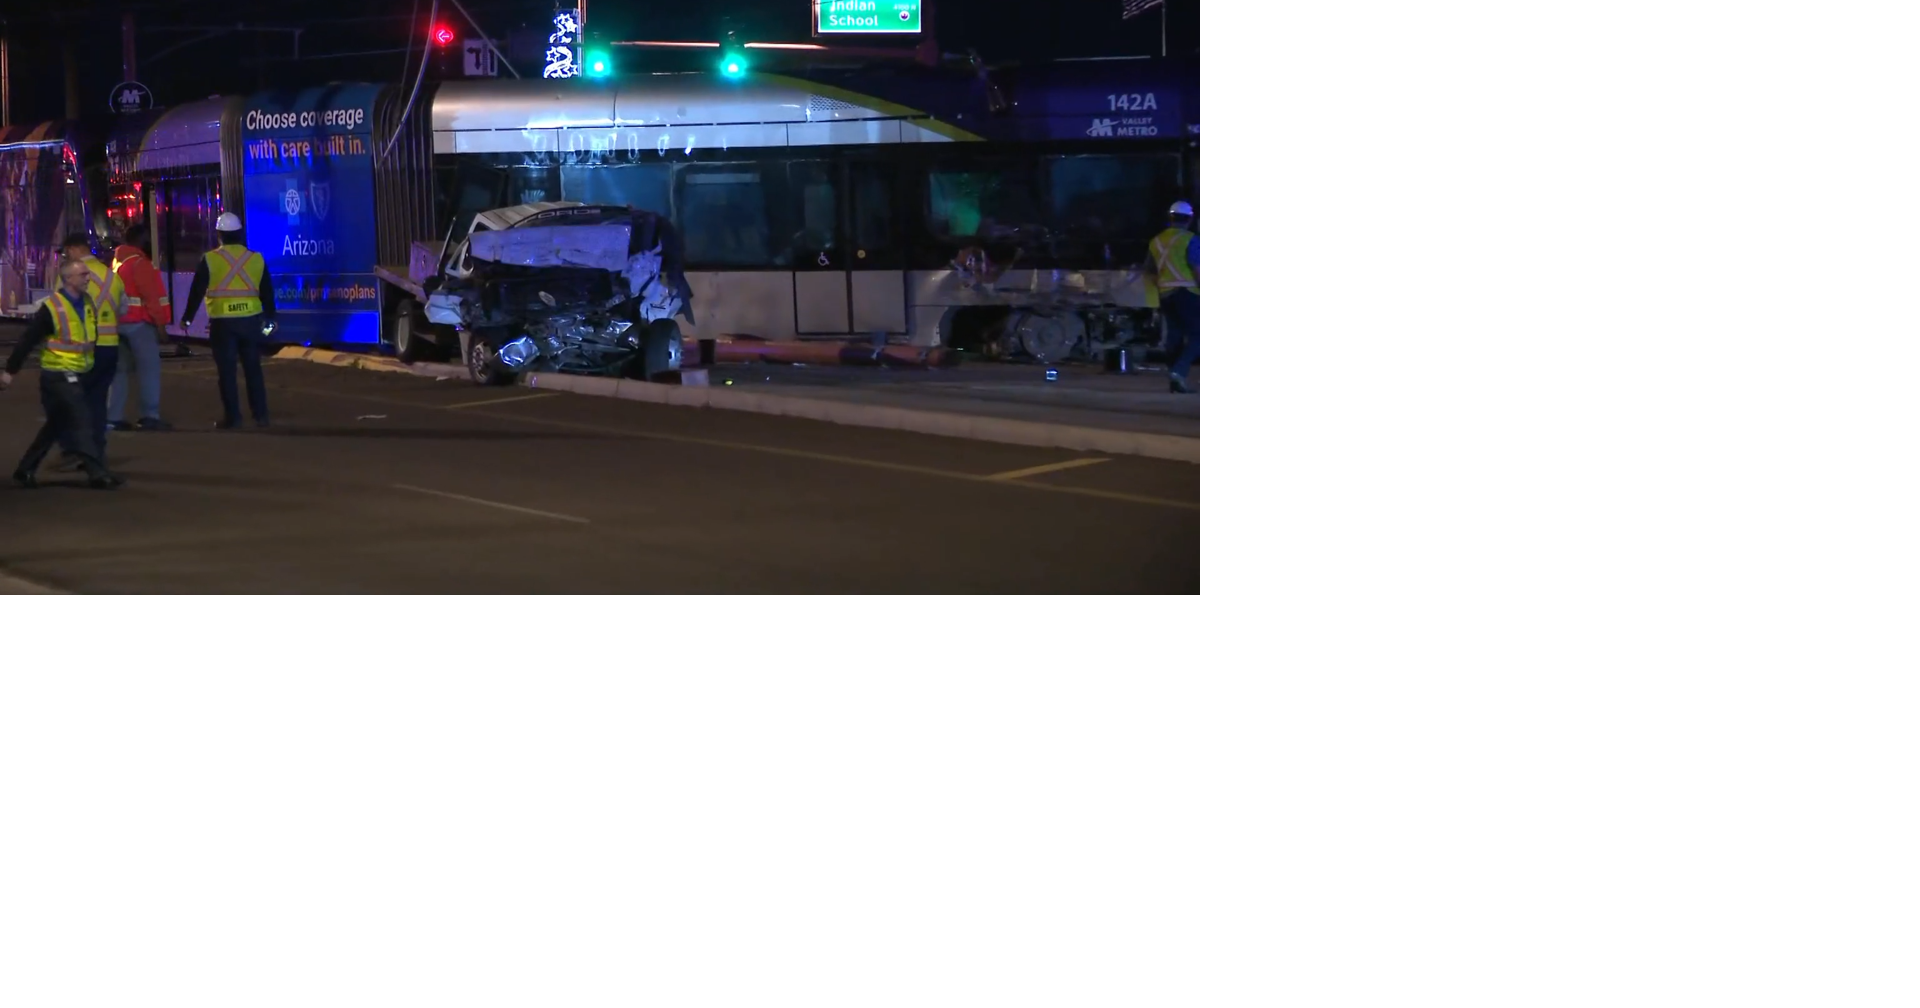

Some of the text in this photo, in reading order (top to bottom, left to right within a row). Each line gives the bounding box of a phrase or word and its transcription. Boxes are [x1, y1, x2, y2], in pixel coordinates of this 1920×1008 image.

[830, 0, 876, 11] Indian
[829, 14, 878, 26] School
[1107, 92, 1158, 111] 142A
[246, 107, 364, 130] Choose coverage
[1122, 117, 1152, 125] VALLEY
[1117, 126, 1158, 136] METRO
[249, 134, 366, 159] with care built in.
[282, 234, 335, 256] Arizona
[228, 302, 249, 312] SAFETY
